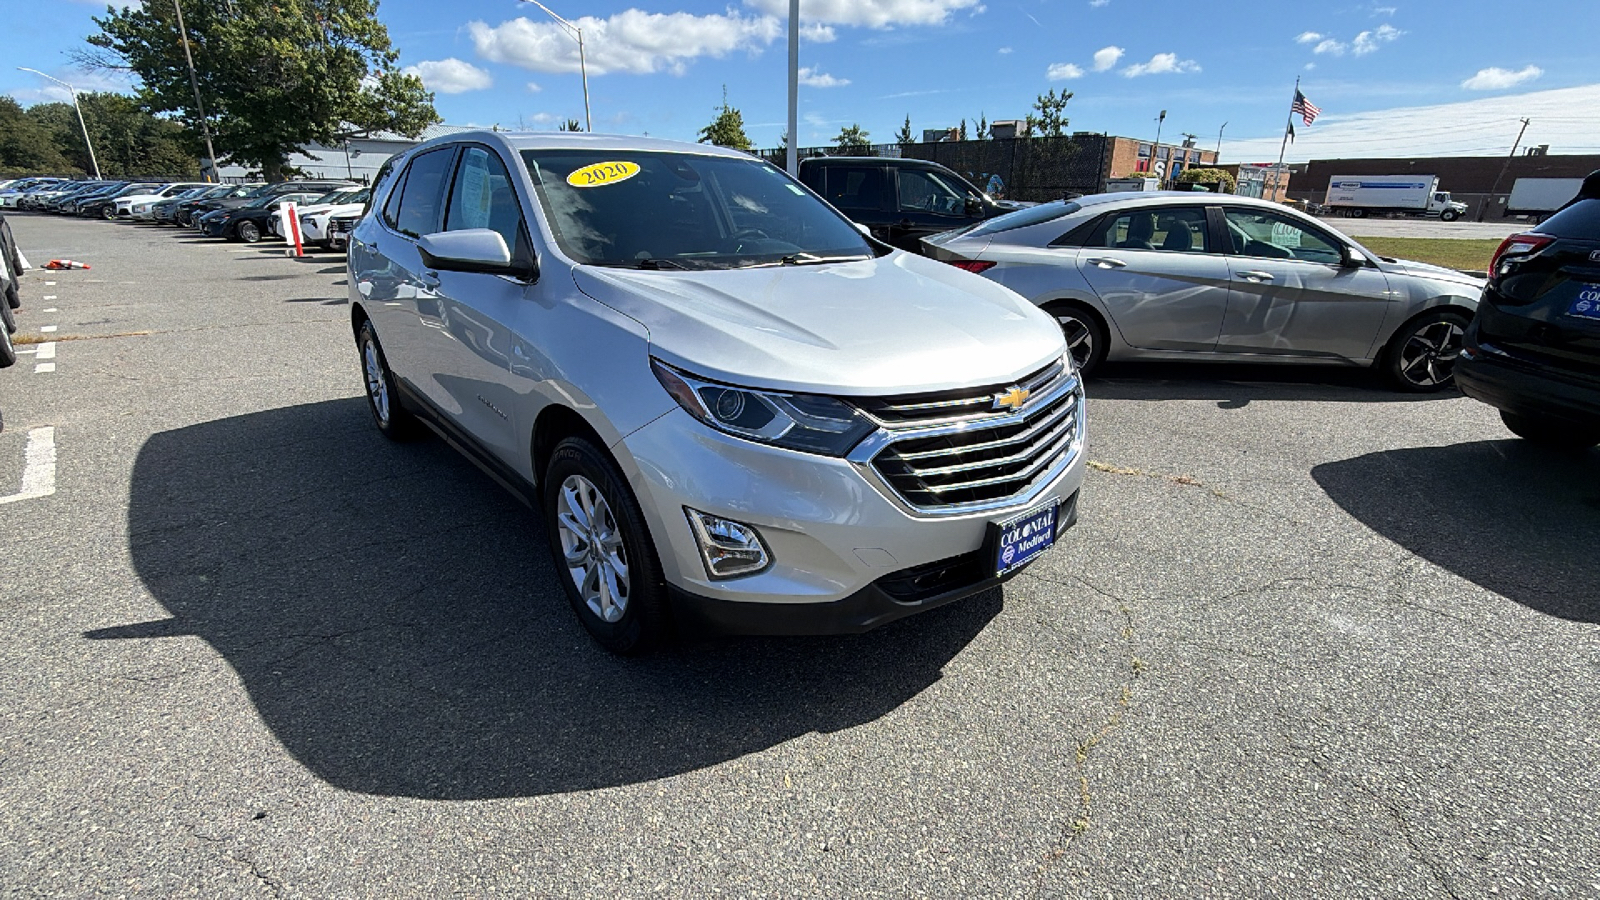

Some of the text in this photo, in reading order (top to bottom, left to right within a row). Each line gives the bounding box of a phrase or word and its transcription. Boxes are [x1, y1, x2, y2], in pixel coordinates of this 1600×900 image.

[582, 163, 628, 184] 2020
[1001, 512, 1054, 548] COLONIAL
[1017, 528, 1051, 554] Medford
